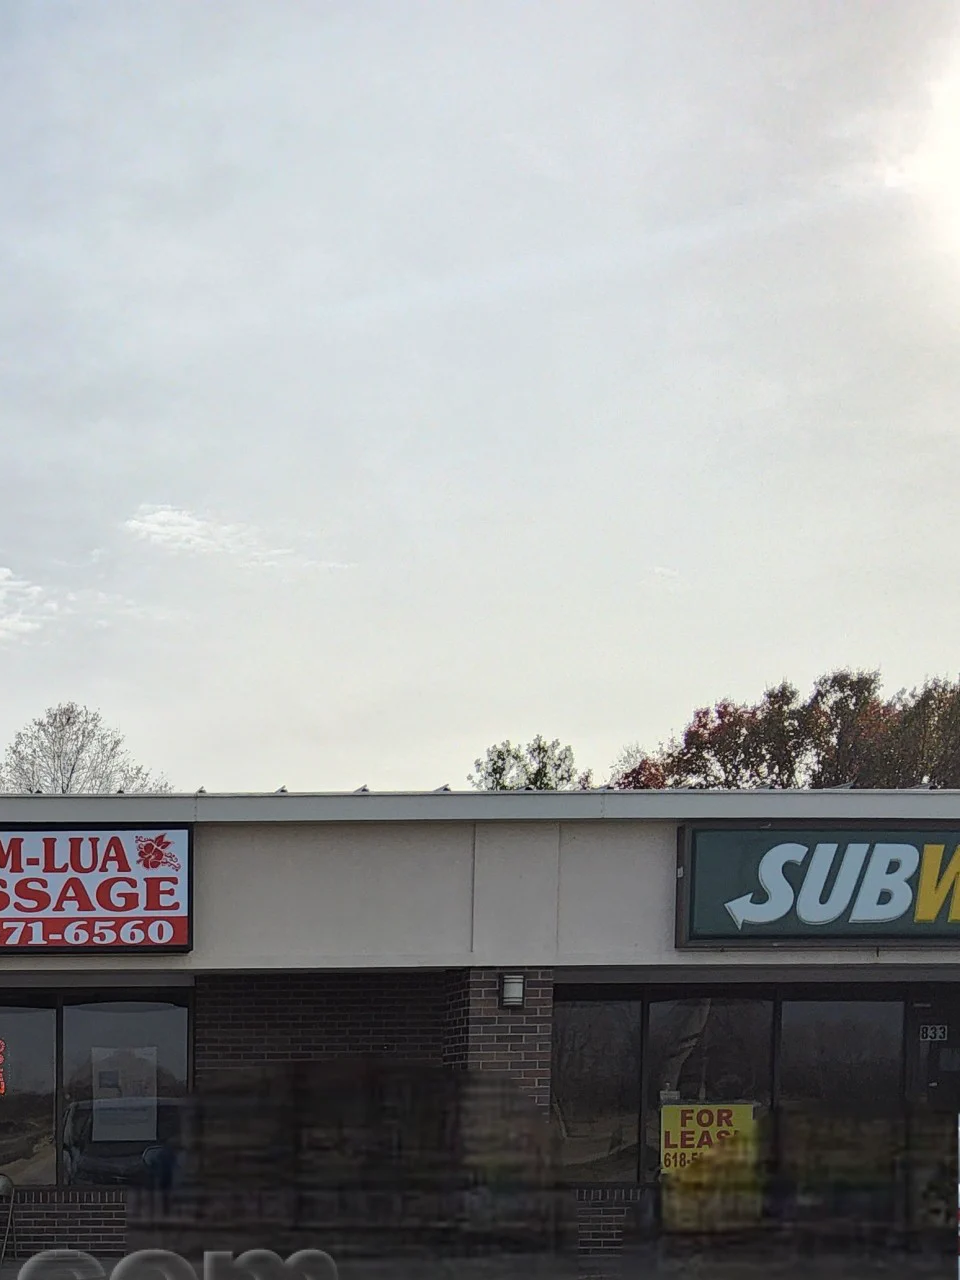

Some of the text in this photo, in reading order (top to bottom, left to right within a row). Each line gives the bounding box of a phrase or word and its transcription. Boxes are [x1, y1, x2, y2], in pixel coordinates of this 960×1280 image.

[921, 1025, 947, 1040] 833
[680, 1109, 734, 1127] FOR
[664, 1130, 740, 1149] LEA
